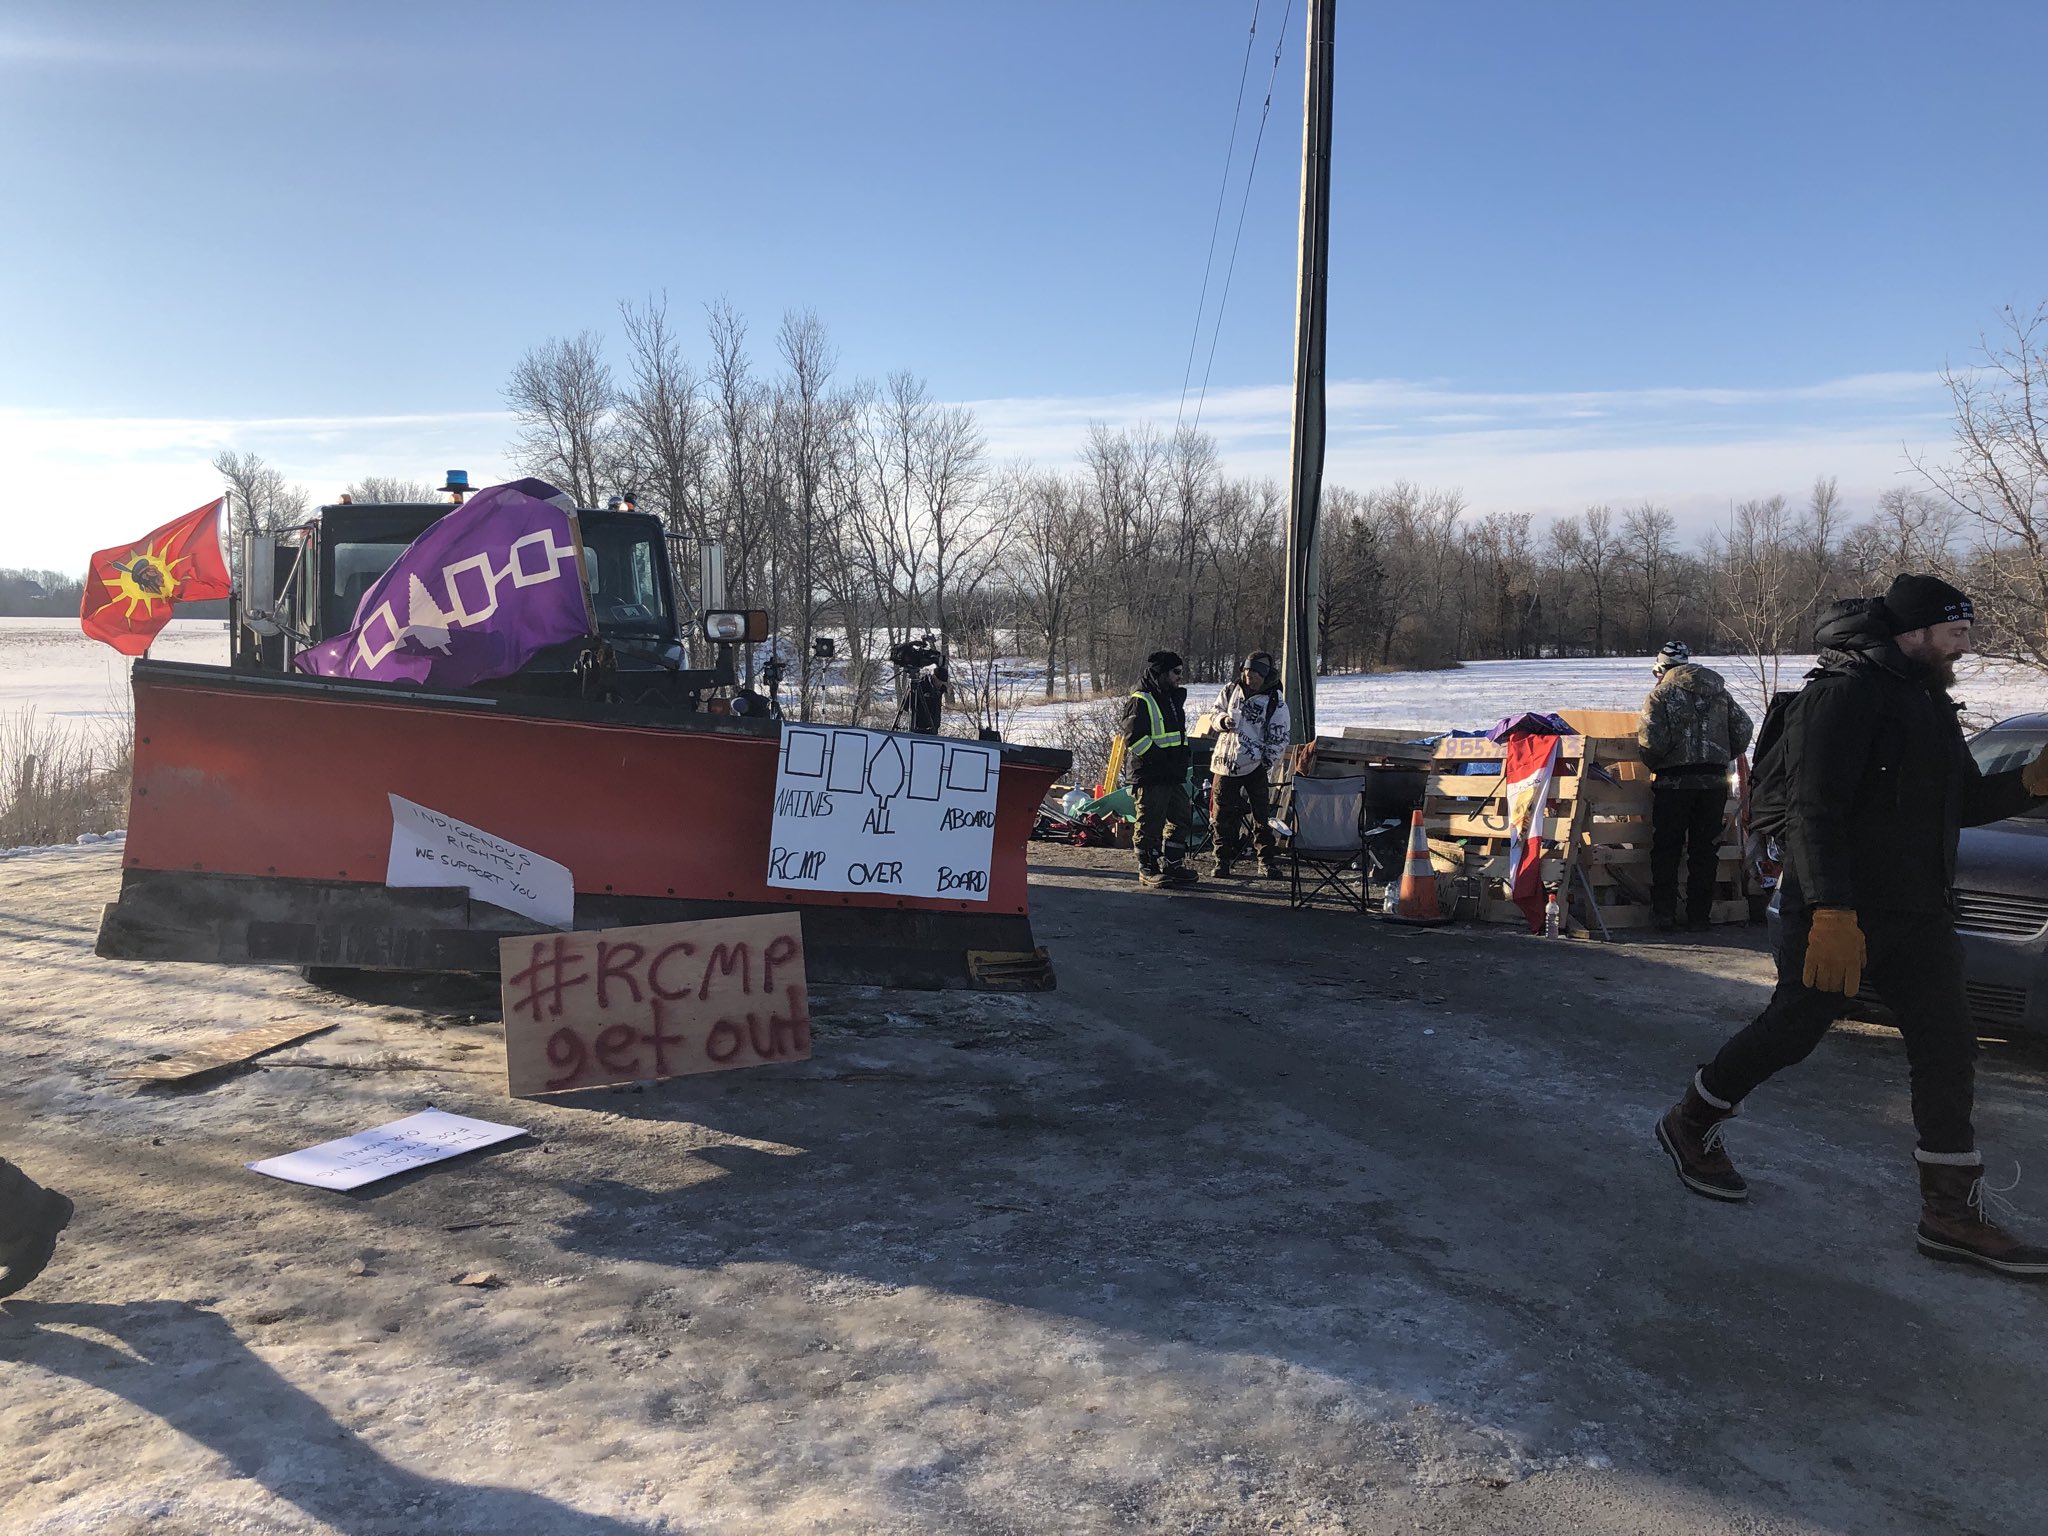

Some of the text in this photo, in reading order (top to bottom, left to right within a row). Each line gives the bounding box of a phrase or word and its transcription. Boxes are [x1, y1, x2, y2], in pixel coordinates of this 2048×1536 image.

[774, 787, 834, 818] NATIVES
[862, 807, 996, 835] ALL ABOARD
[413, 808, 531, 867] INDIGENOUS
[447, 835, 524, 875] RIGHTS!
[415, 847, 538, 900] WE SUPPORT YOU
[847, 861, 903, 886] OVER
[936, 866, 988, 892] BOARD
[508, 935, 798, 1022] #RCMP
[545, 983, 812, 1092] get out
